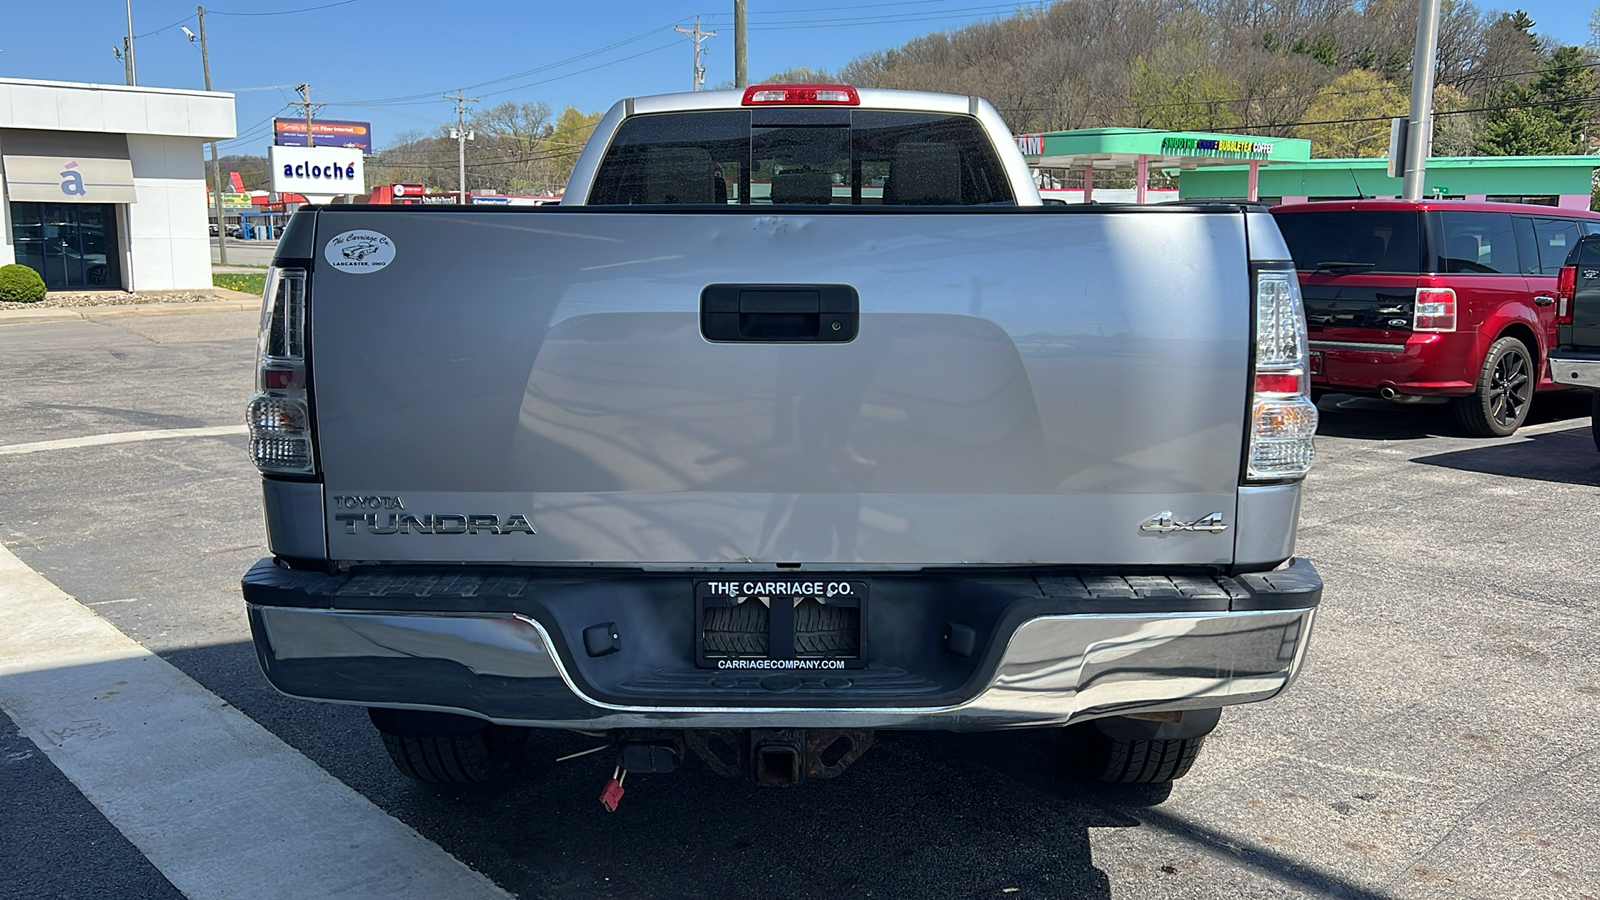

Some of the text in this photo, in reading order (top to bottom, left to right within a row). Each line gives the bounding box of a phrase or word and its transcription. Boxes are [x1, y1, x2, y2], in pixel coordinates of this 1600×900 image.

[1252, 142, 1274, 154] COFFEE
[284, 161, 355, 179] acloché
[332, 237, 344, 246] The
[346, 233, 377, 243] Carriage
[334, 496, 405, 510] TOYOTA
[335, 513, 537, 535] TUNDRA
[1140, 510, 1228, 534] 4x4
[708, 582, 854, 595] THE CARRIAGE CO.
[717, 660, 845, 669] CARRIAGECOMPANY.COM
